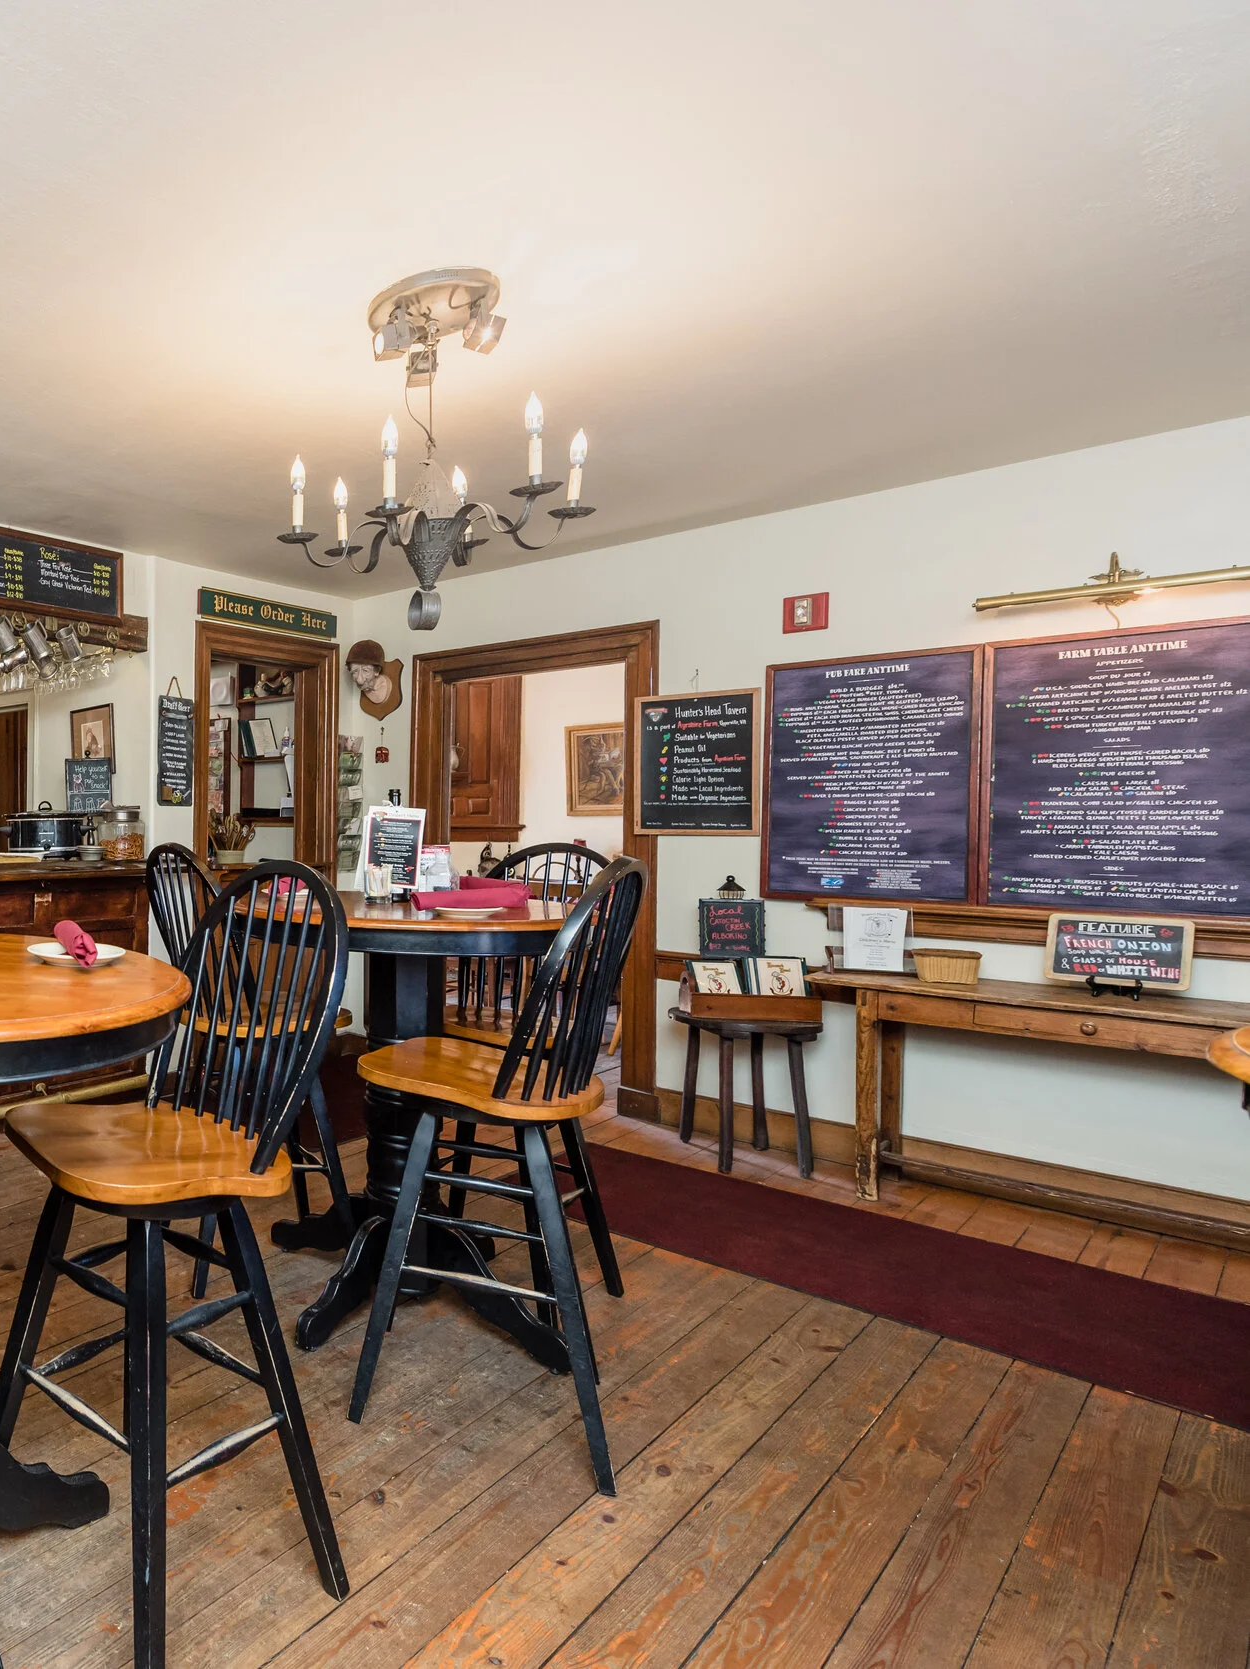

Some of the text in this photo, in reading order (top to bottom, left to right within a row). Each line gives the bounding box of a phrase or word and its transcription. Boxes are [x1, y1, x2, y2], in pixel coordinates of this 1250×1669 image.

[214, 594, 327, 630] Please Order Here
[1058, 639, 1189, 660] FARM TABLE ANYTIME
[1096, 657, 1144, 667] APPETIZERS
[825, 664, 911, 679] PUB FARE ANYTIME
[178, 701, 191, 713] Beer
[675, 702, 747, 718] Hunter's Head Tavern
[674, 733, 699, 742] Suitable
[674, 745, 695, 754] Peanut
[673, 756, 700, 764] Products
[74, 764, 108, 777] Help yourself
[698, 794, 719, 802] Organic
[709, 905, 744, 917] Local
[1078, 922, 1154, 935] FEATURE
[1063, 935, 1172, 952] FRENCH ONION
[1061, 958, 1070, 970] &
[1072, 964, 1181, 979] RED WHITE WINE
